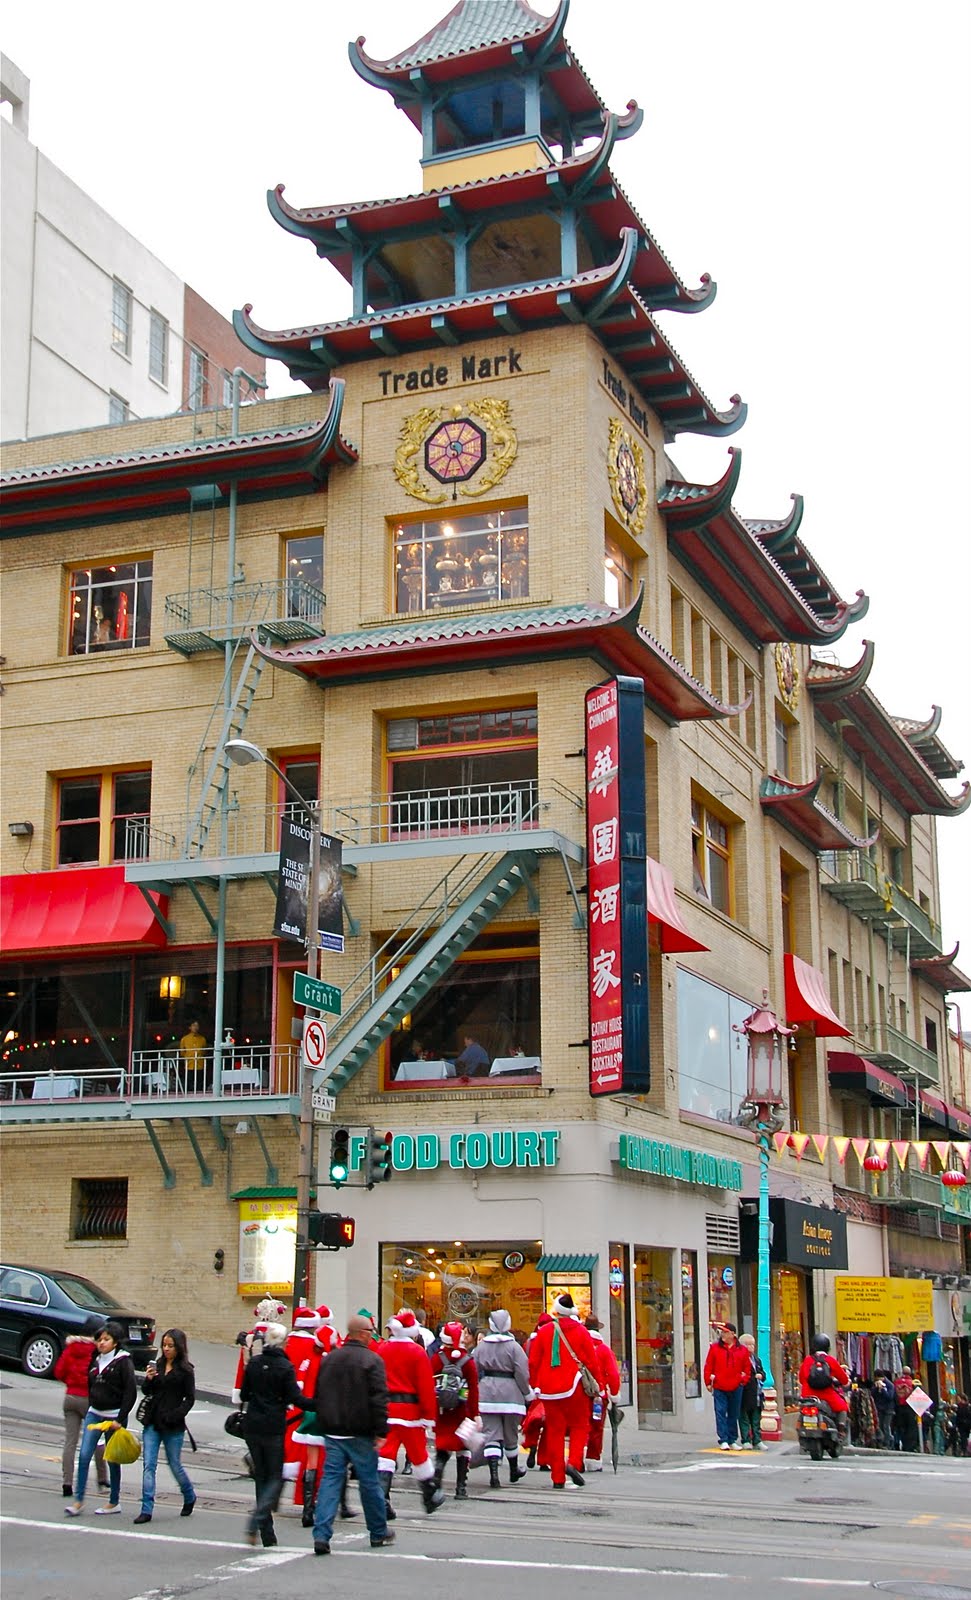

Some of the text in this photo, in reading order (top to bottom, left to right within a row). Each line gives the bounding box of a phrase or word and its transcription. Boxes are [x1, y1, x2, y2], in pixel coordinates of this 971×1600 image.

[379, 349, 523, 395] Trade Mark
[587, 690, 610, 714] WELCOME
[589, 704, 617, 730] CHINATOWN
[289, 823, 332, 849] DISCOERY
[282, 867, 298, 881] STATE
[286, 858, 297, 870] THE
[285, 878, 302, 891] MIND
[304, 983, 333, 1007] Grant
[592, 1016, 622, 1037] CATHAY HOUSE
[592, 1034, 622, 1054] RESTAURANT
[592, 1053, 618, 1072] COCKTAILS
[313, 1095, 334, 1110] GRANT
[350, 1130, 560, 1171] FOD COURT
[621, 1134, 743, 1192] CHINATOWN FOOD COURT
[344, 1224, 352, 1240] 9
[802, 1220, 833, 1244] Asian Image
